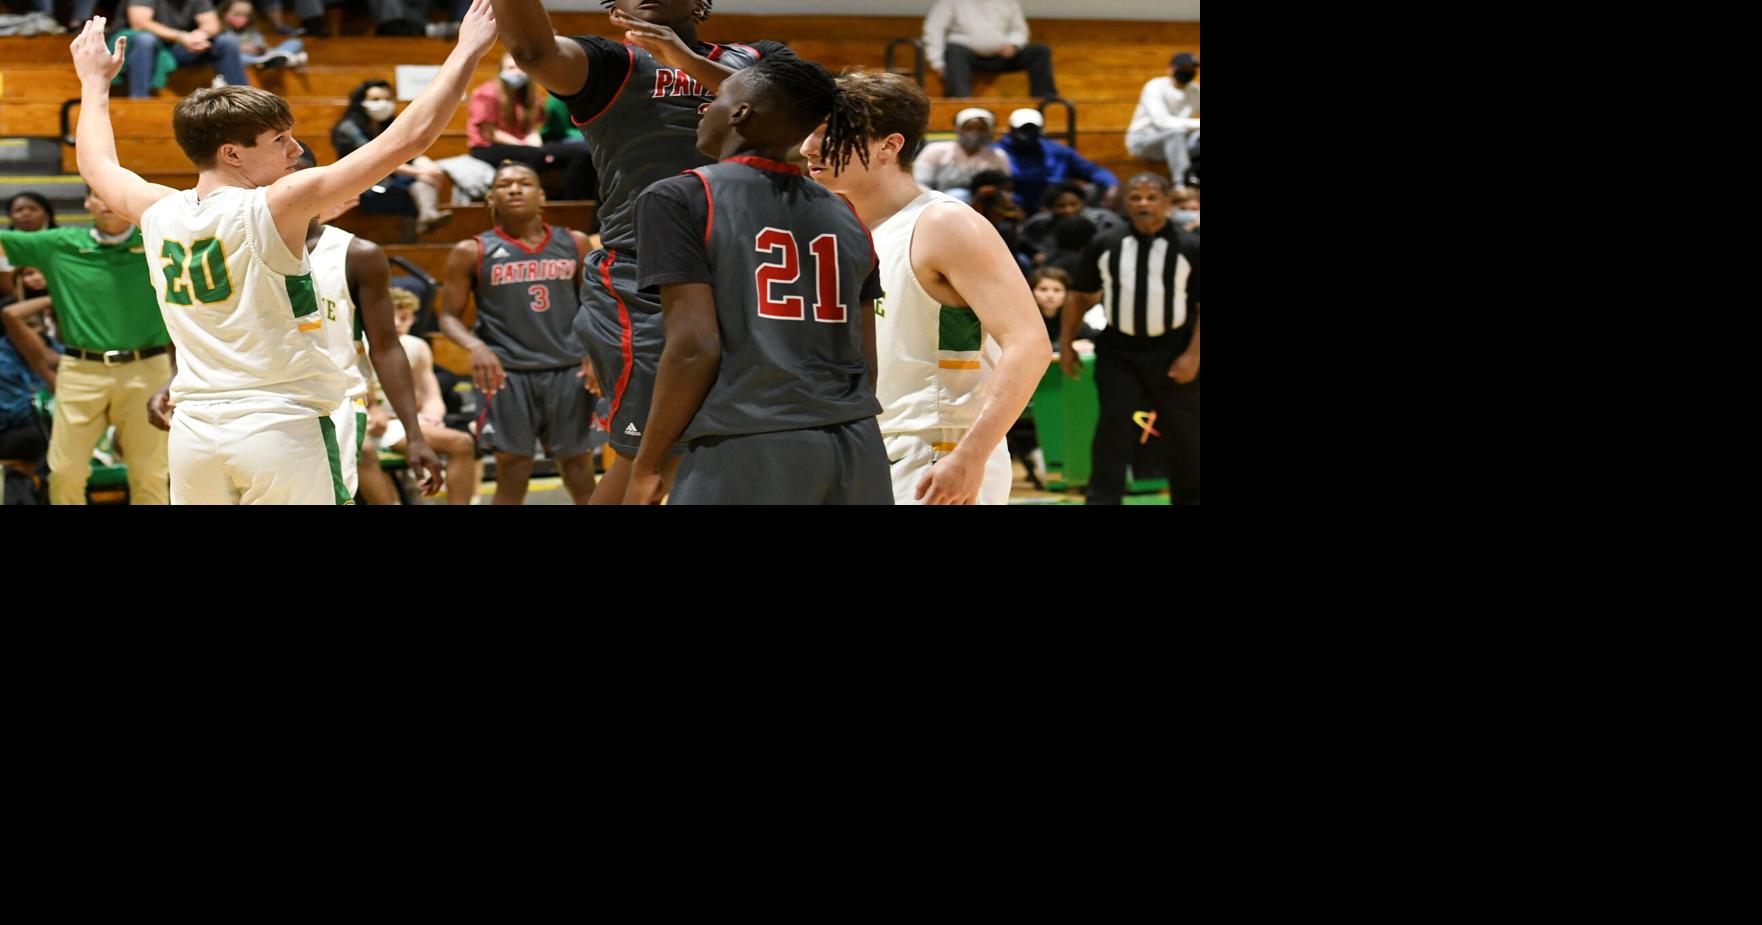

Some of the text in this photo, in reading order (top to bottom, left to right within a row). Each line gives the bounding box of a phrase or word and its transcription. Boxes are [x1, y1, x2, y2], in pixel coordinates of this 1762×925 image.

[160, 236, 236, 307] 20
[528, 284, 551, 312] 3
[755, 226, 847, 323] 21
